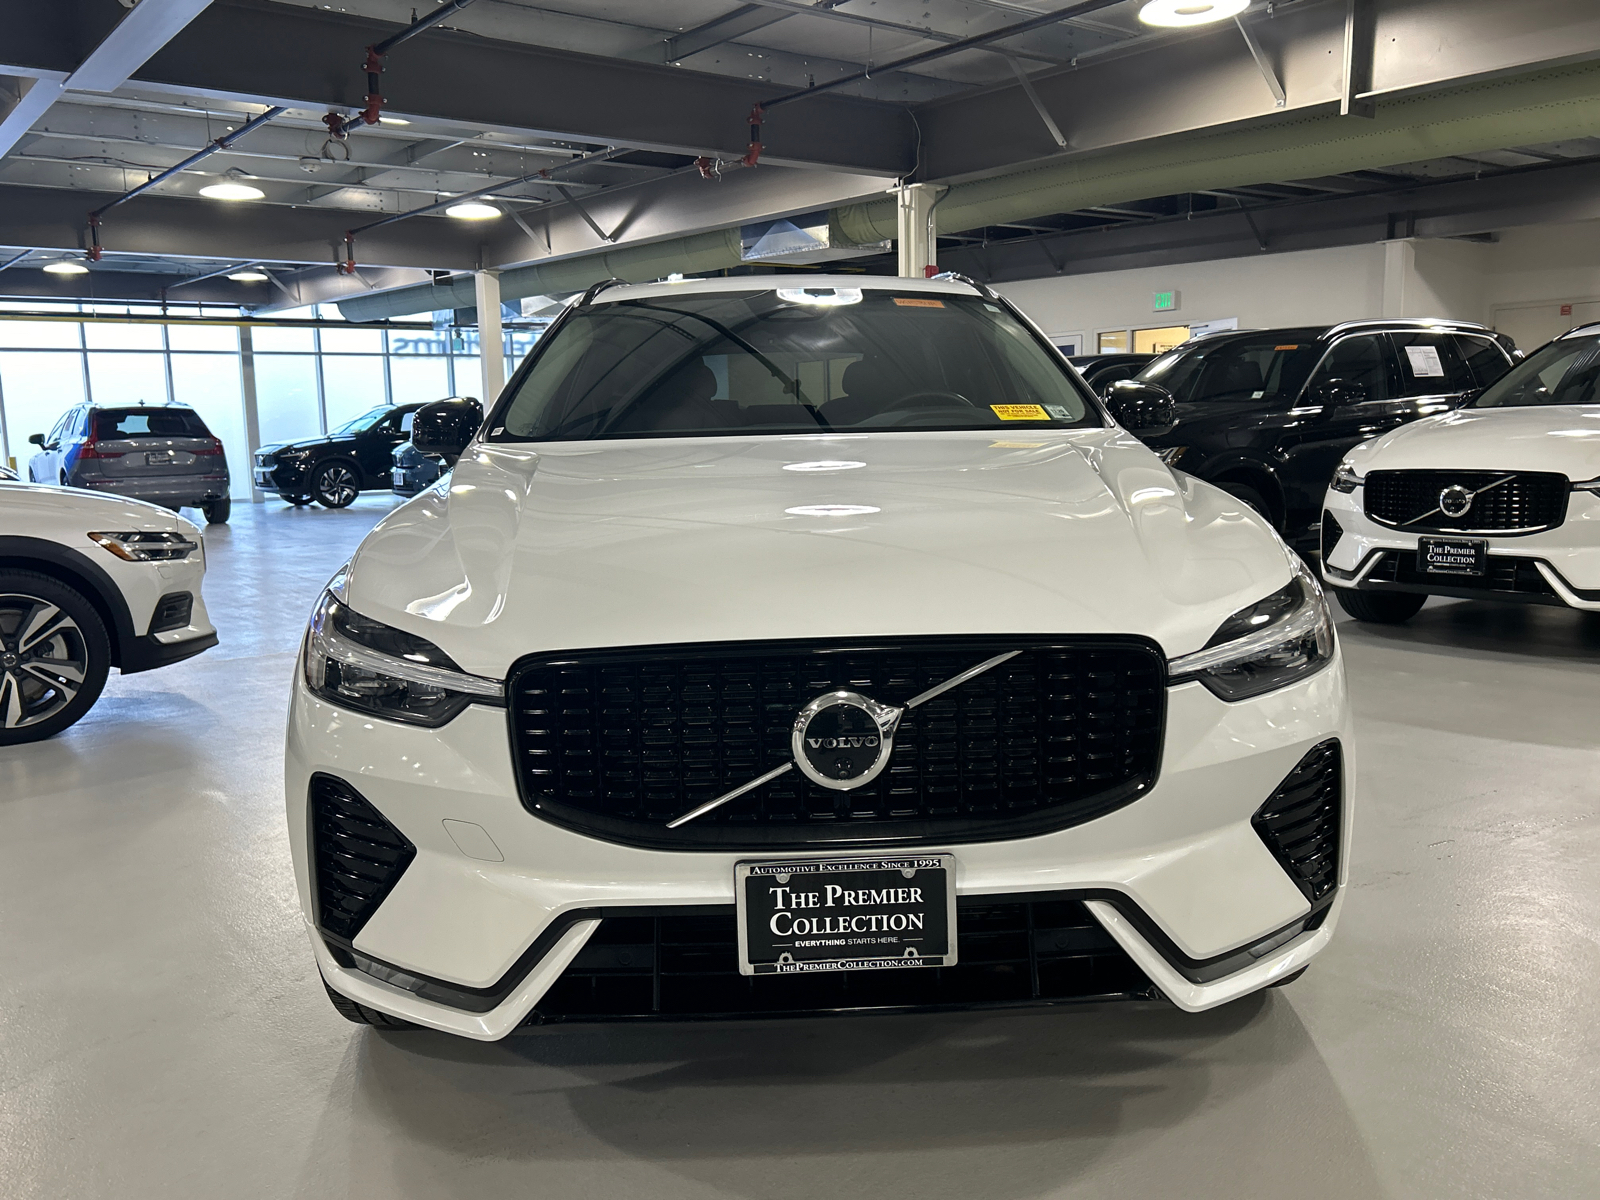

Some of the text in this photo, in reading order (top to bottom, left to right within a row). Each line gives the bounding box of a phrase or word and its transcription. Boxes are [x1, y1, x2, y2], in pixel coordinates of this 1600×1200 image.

[1155, 292, 1171, 308] EXIT
[1427, 544, 1476, 555] THE PREMIER
[1427, 553, 1476, 564] COLLECTION
[806, 736, 879, 749] VOLVO
[752, 859, 940, 875] AUTOMOTIVE EXCELLENCE SINCE 1995
[768, 884, 924, 910] THE PREMIER
[769, 911, 925, 936] COLLECTION
[795, 939, 846, 948] EVERYTHING
[774, 958, 924, 973] THEPREMIERCOLLECTION.COM
